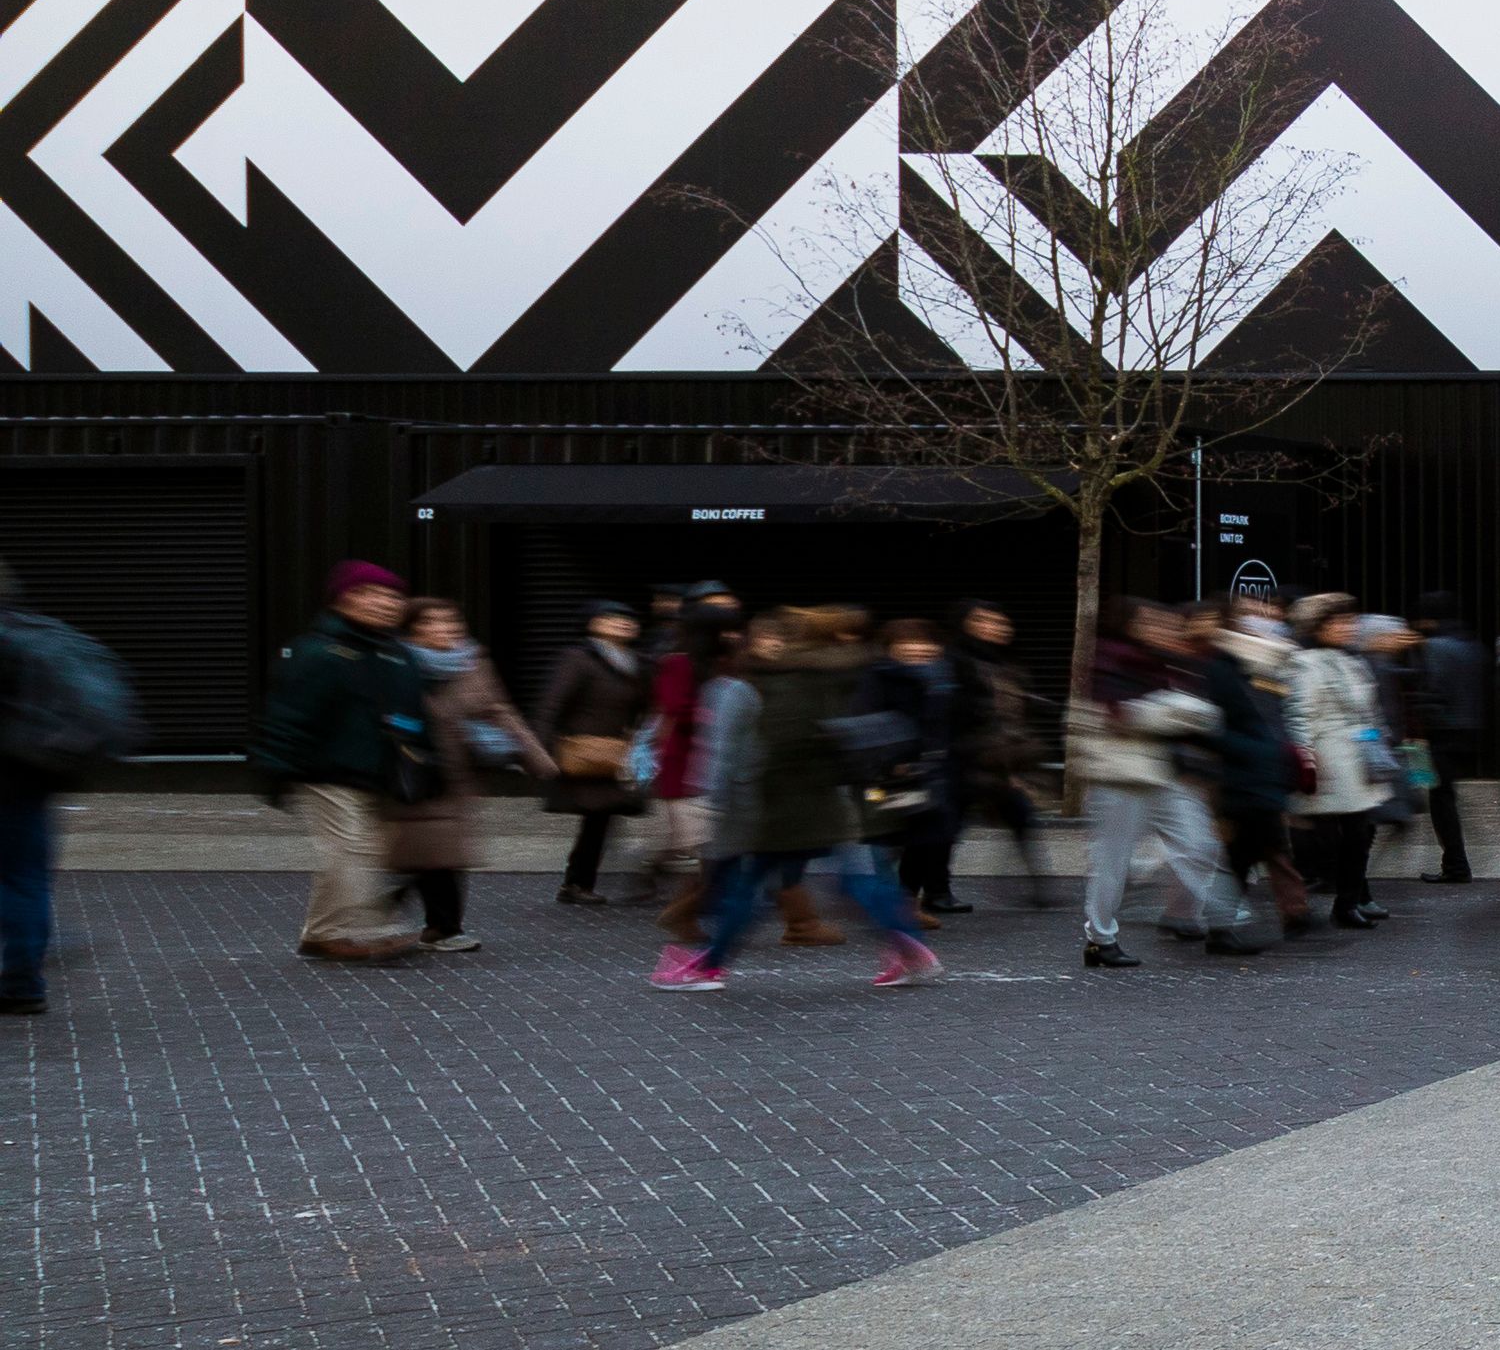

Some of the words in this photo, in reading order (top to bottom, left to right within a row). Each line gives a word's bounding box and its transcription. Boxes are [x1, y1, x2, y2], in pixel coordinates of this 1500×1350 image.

[417, 509, 434, 520] 02
[691, 509, 720, 520] BOKI
[721, 509, 765, 520] COFFEE
[1220, 514, 1249, 525] BOXPARK
[1220, 533, 1234, 543] UNIT
[1234, 534, 1244, 544] 02
